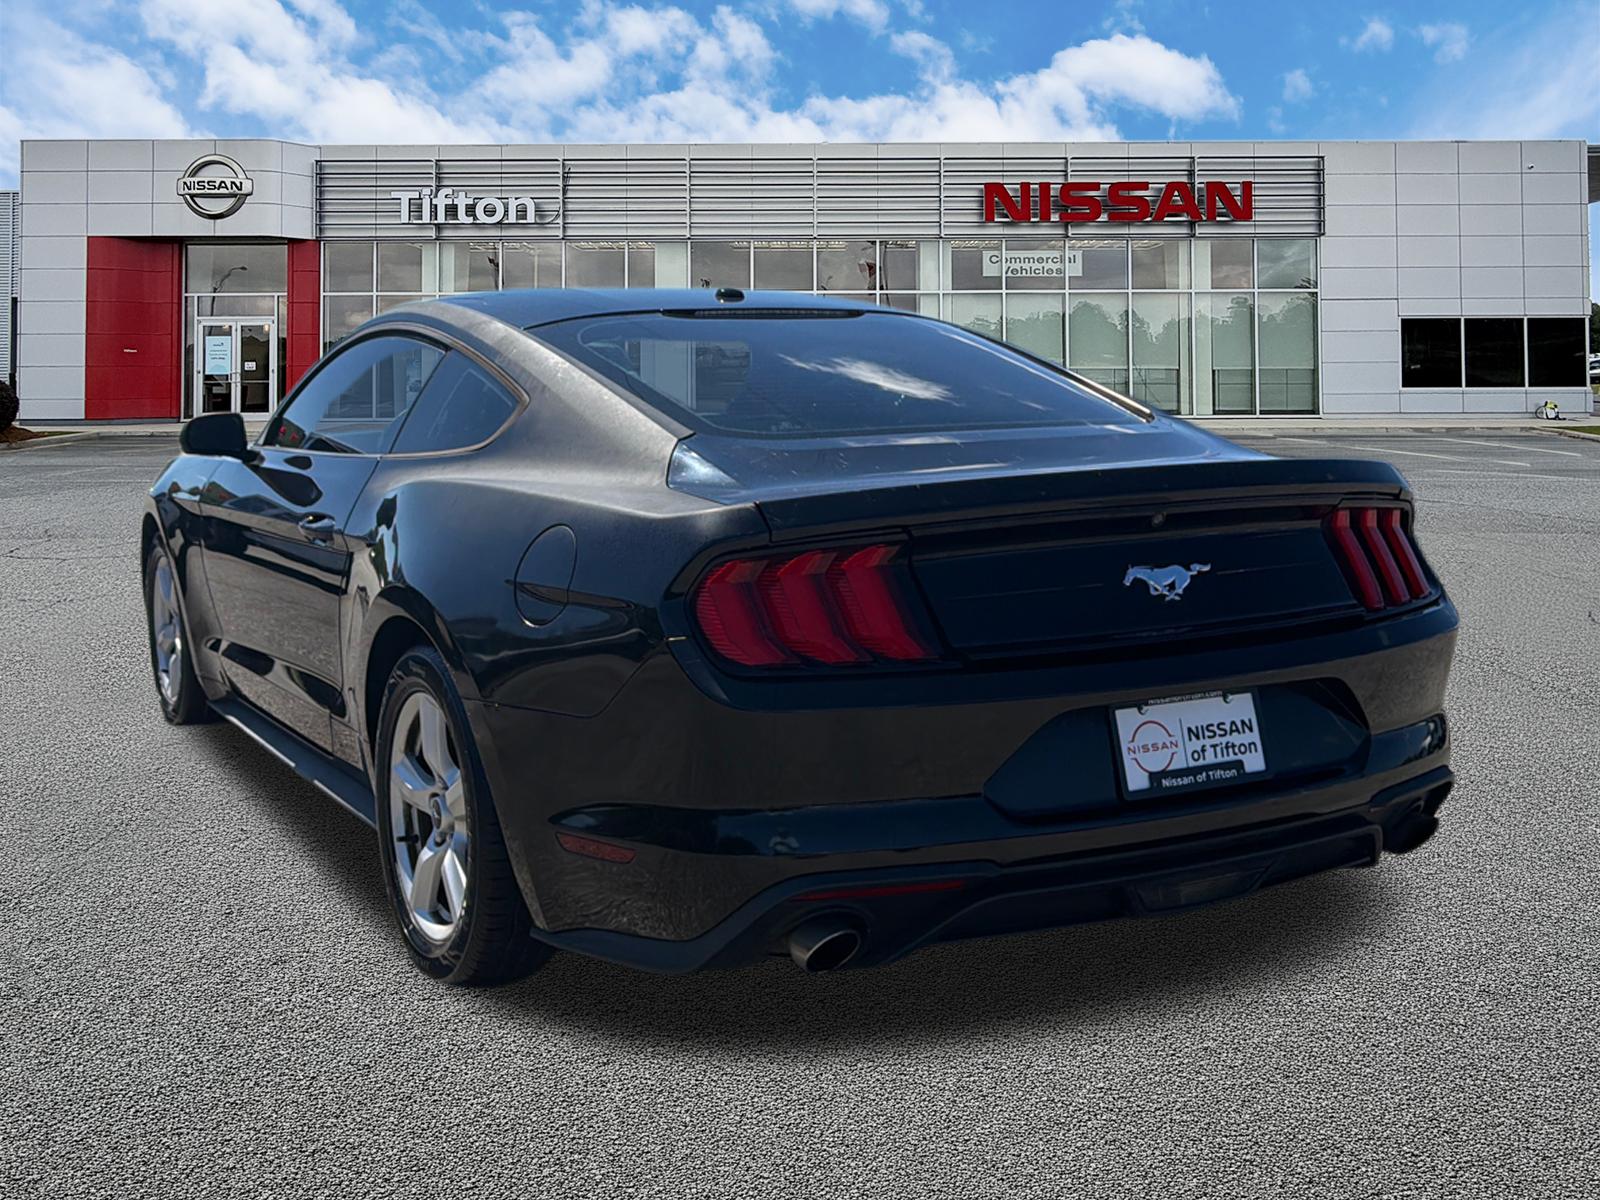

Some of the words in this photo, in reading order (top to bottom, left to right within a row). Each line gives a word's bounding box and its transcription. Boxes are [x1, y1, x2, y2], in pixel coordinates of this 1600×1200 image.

[182, 180, 243, 191] NISSAN
[391, 188, 536, 223] Tifton
[984, 181, 1253, 222] NISSAN
[1187, 718, 1254, 741] NISSAN
[1127, 740, 1179, 755] NISSAN
[1191, 744, 1207, 762] of
[1209, 741, 1258, 759] Tifton
[1161, 776, 1195, 788] Nissan
[1196, 771, 1207, 782] of
[1208, 768, 1238, 781] Tifton
